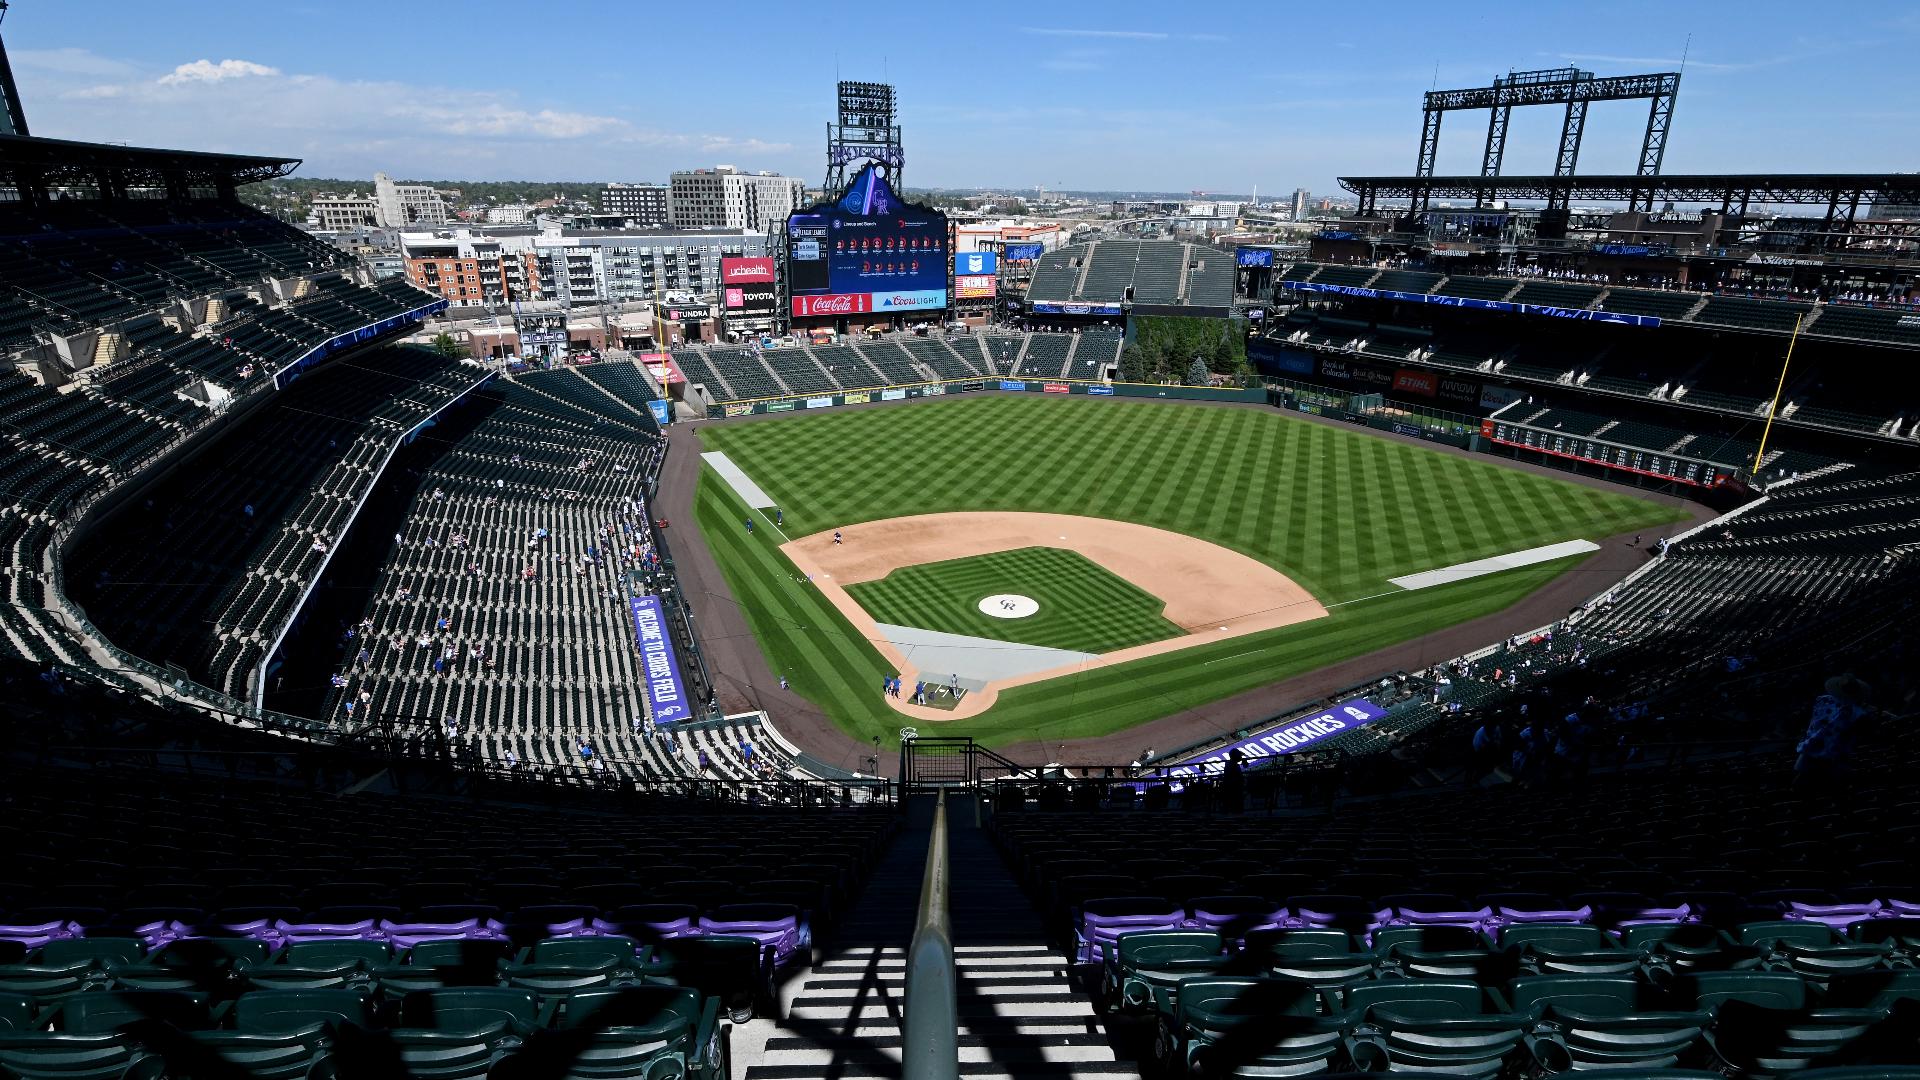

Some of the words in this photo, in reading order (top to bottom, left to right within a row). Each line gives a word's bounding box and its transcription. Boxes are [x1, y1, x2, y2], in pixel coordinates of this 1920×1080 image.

[730, 264, 767, 275] uchealth
[743, 292, 774, 301] TOYOTA
[893, 295, 916, 306] Coors
[916, 296, 938, 305] LIGHT
[678, 310, 708, 318] TUNDRA
[1321, 367, 1350, 379] Colorado
[1399, 376, 1431, 390] STIHL
[1441, 381, 1477, 394] ARROW
[637, 608, 662, 640] WELCOME
[644, 641, 664, 652] TO
[646, 652, 672, 679] COORS
[652, 678, 678, 702] FIELD
[1260, 713, 1346, 753] ROCKIES
